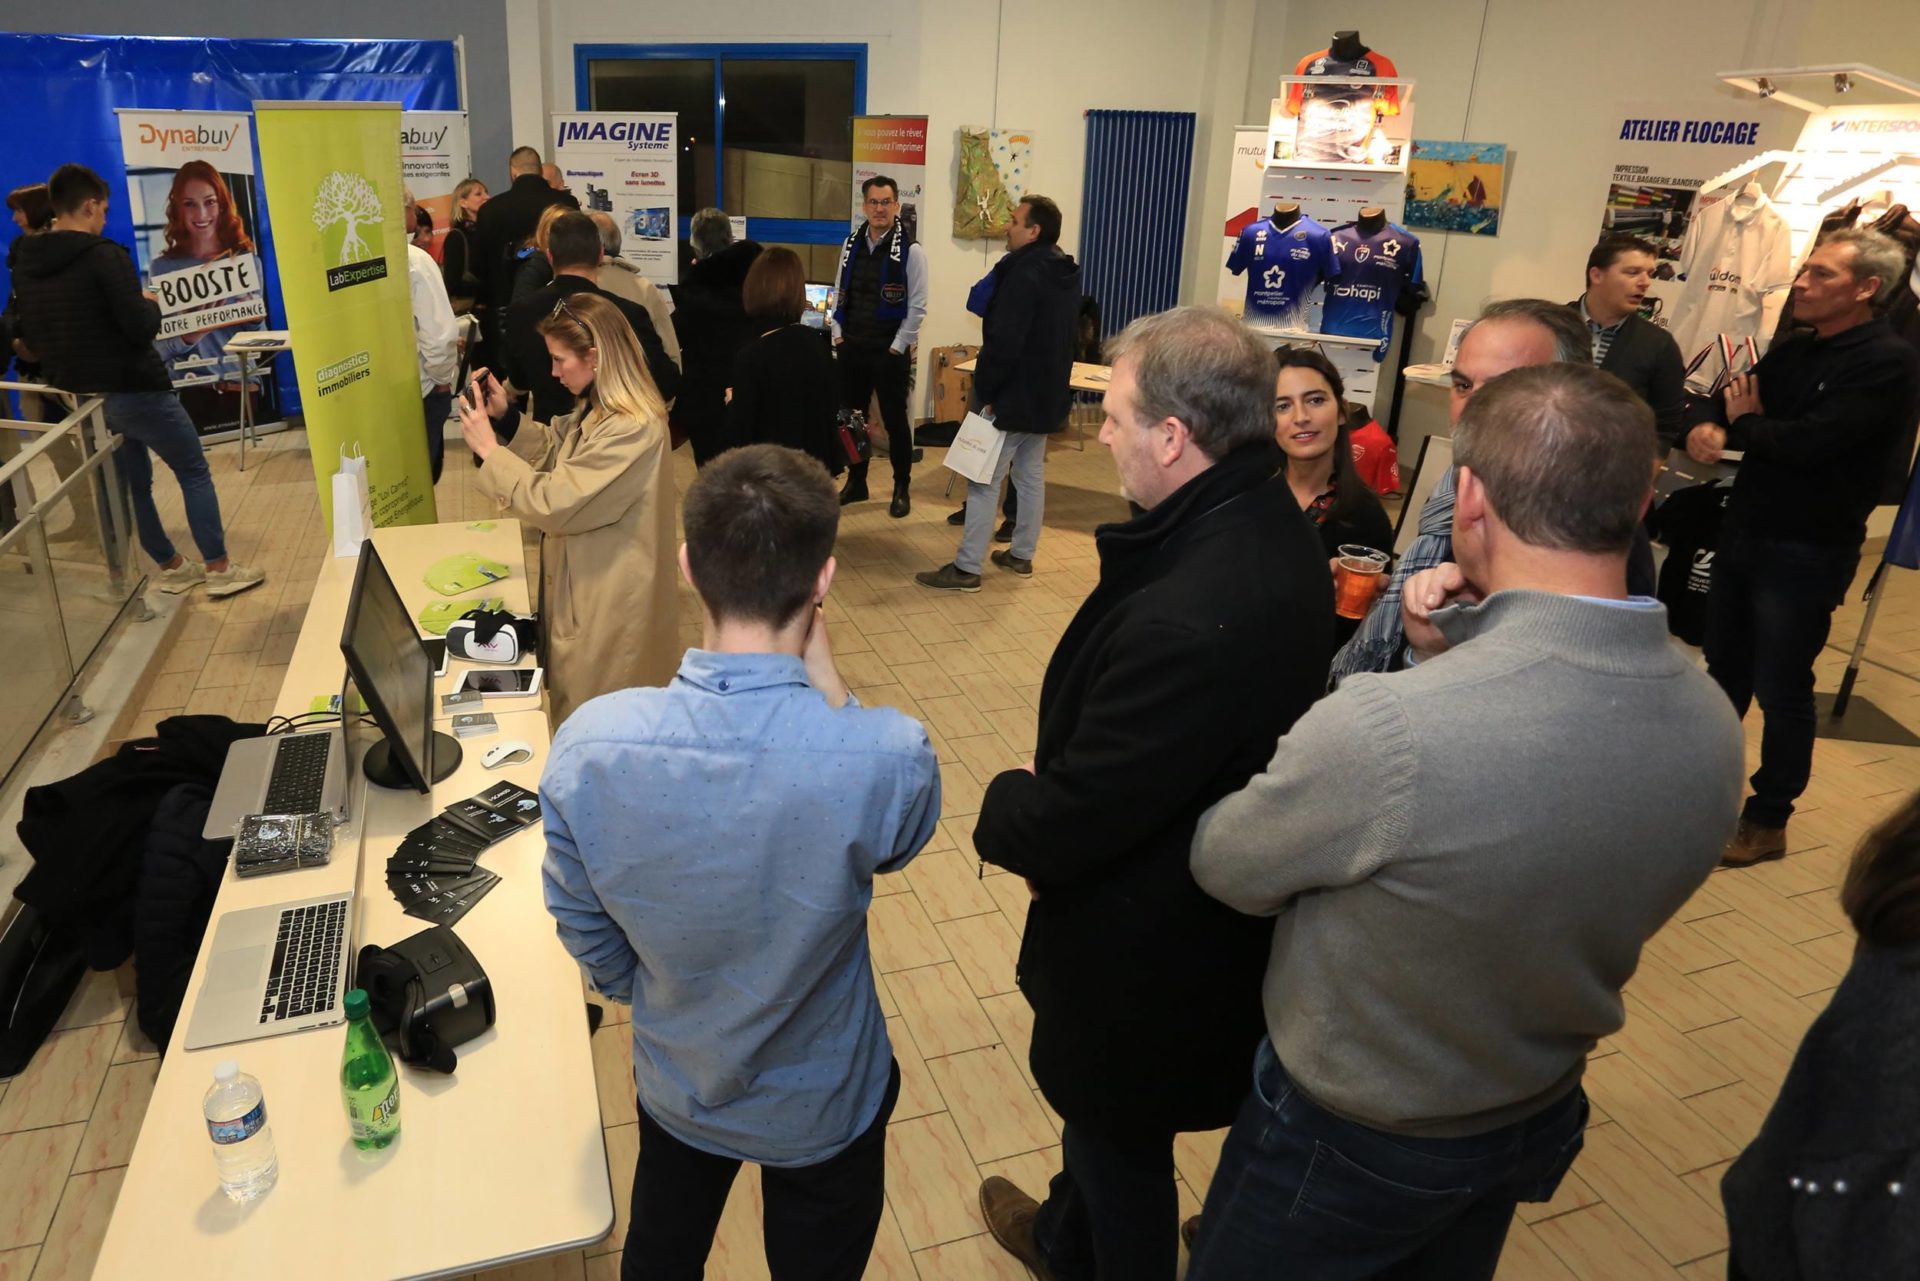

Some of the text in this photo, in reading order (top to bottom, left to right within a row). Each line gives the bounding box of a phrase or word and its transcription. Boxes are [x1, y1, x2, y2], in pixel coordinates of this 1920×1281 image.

[138, 123, 239, 152] Dynabuy
[558, 121, 673, 147] IMAGINE
[899, 128, 906, 137] le
[1619, 119, 1760, 145] ATELIER FLOCAGE
[627, 141, 669, 151] Systeme
[160, 262, 250, 307] BOOSTE
[329, 263, 386, 287] LabExpertise
[196, 303, 263, 328] PERFORMANCE
[318, 353, 369, 381] diagnostics
[317, 367, 371, 397] immobiliers
